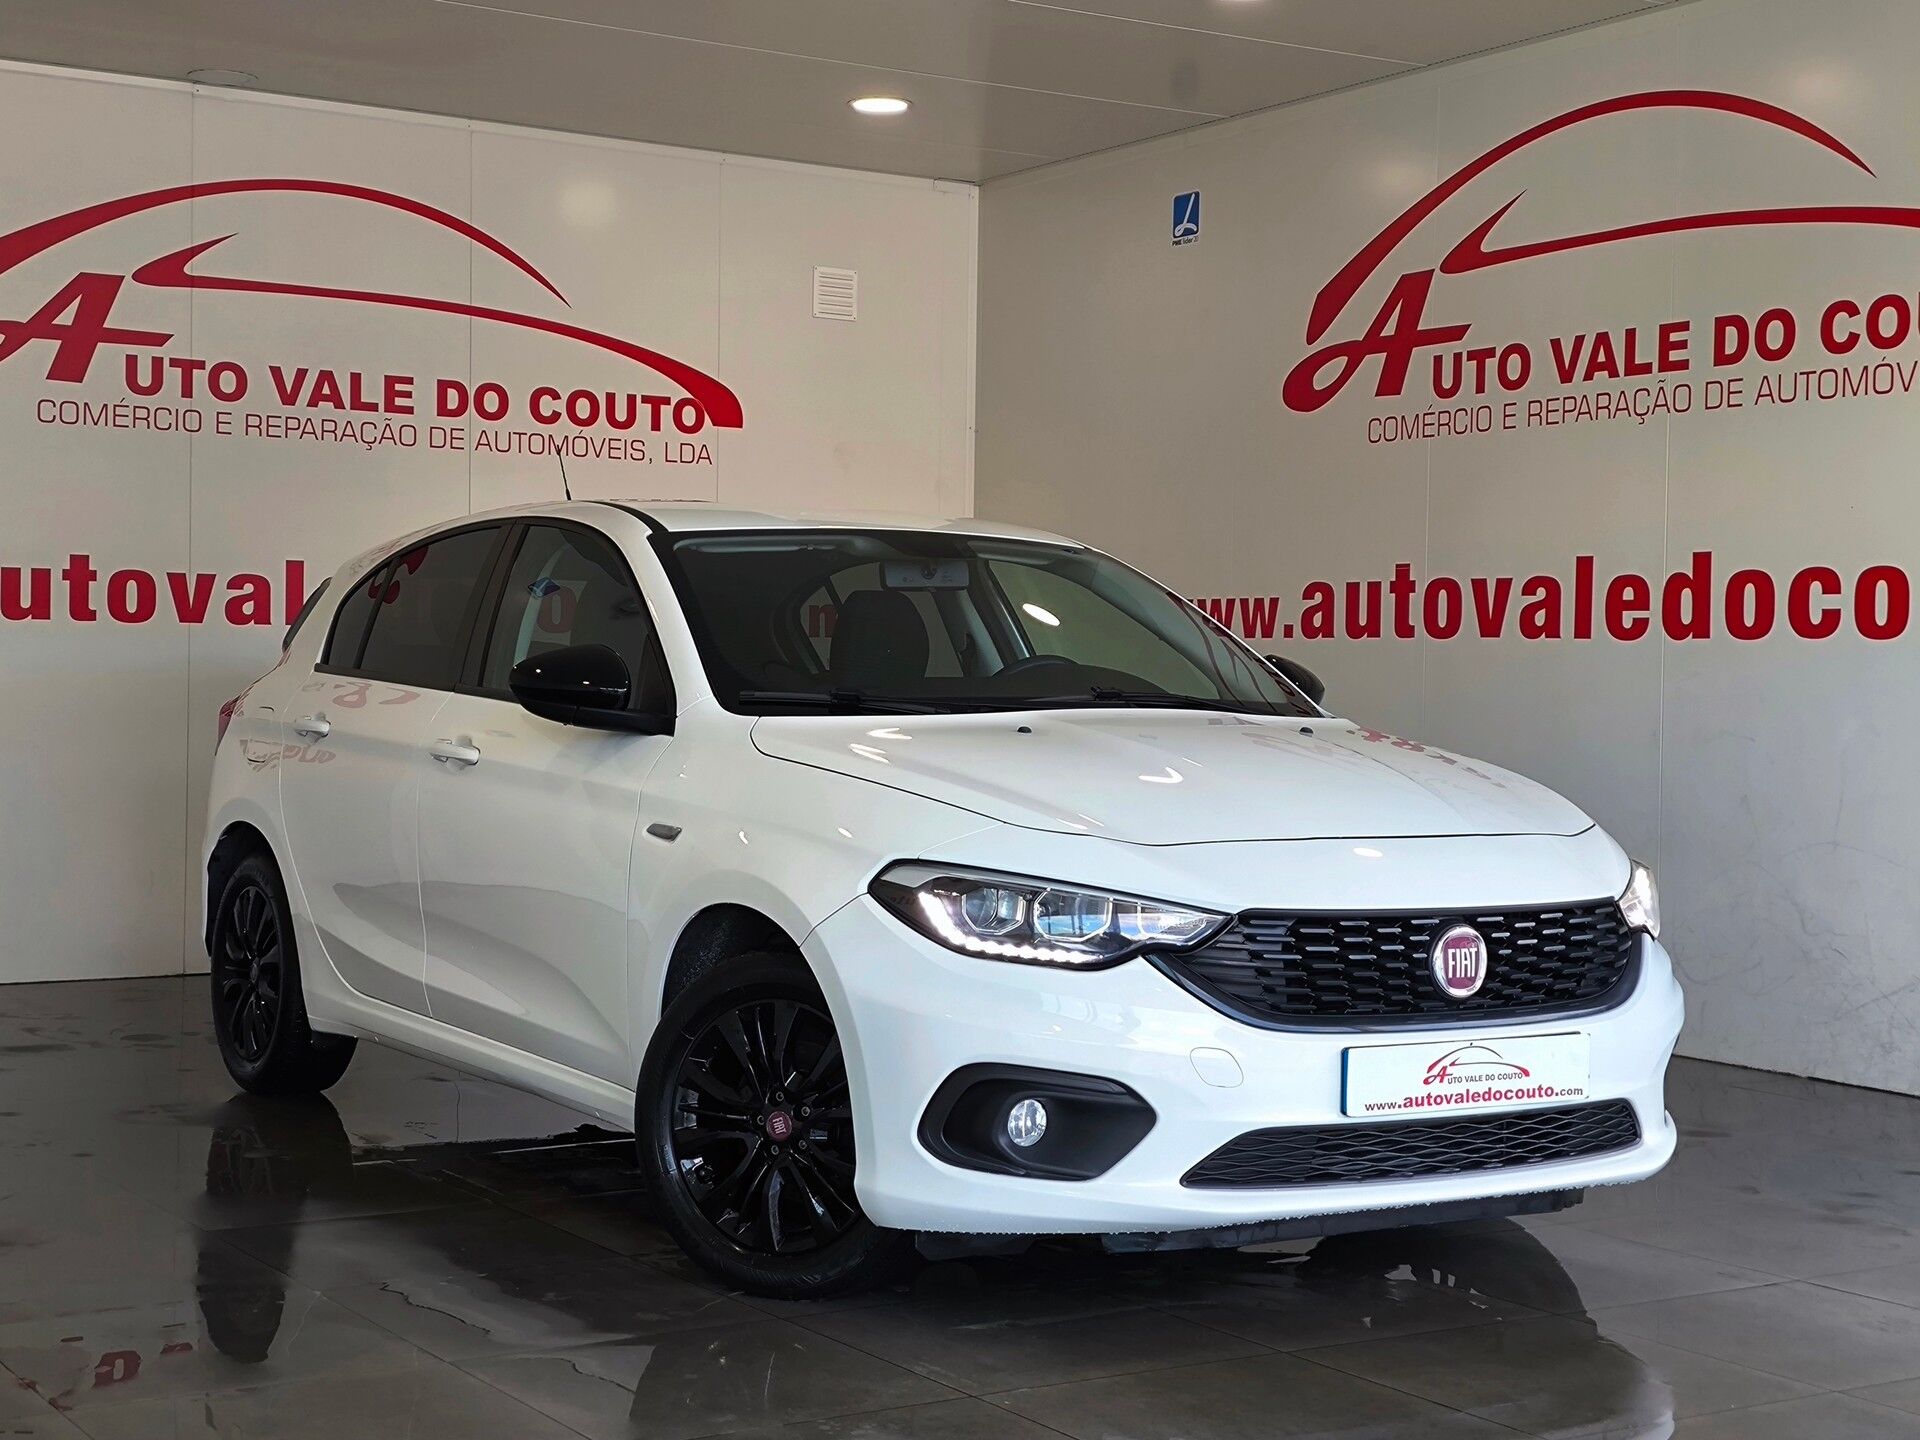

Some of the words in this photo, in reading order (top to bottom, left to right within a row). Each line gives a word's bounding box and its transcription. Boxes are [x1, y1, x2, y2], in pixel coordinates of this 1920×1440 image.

[0, 272, 248, 402] AUTO
[269, 365, 414, 414] VALE
[437, 378, 509, 421] DO
[529, 386, 706, 435] COUTO
[1282, 268, 1532, 412] AUTO
[1549, 320, 1690, 385] VALE
[1713, 307, 1796, 367] DO
[1820, 291, 1920, 355] CO
[37, 397, 202, 433] COMÉRCIO
[215, 411, 232, 436] E
[245, 413, 417, 451] REPARAÇÃO
[429, 426, 465, 450] DE
[475, 429, 653, 464] AUTOMÓVEIS,
[664, 441, 713, 465] LDA
[1368, 404, 1492, 443] COMÉRCIO
[1503, 402, 1517, 430] E
[1527, 378, 1692, 427] REPARAÇÃO
[1704, 377, 1744, 410] DE
[1754, 356, 1918, 406] AUTOMÓV
[1187, 551, 1910, 642] ww.autovaledoco
[1447, 947, 1478, 978] FIAT
[1364, 1084, 1584, 1112] www.autovaledocouto.com
[1423, 1065, 1463, 1085] AUTO
[1465, 1074, 1484, 1083] VALE
[1485, 1073, 1496, 1082] DO
[1497, 1072, 1523, 1081] COUTO
[772, 1116, 787, 1134] FIAT
